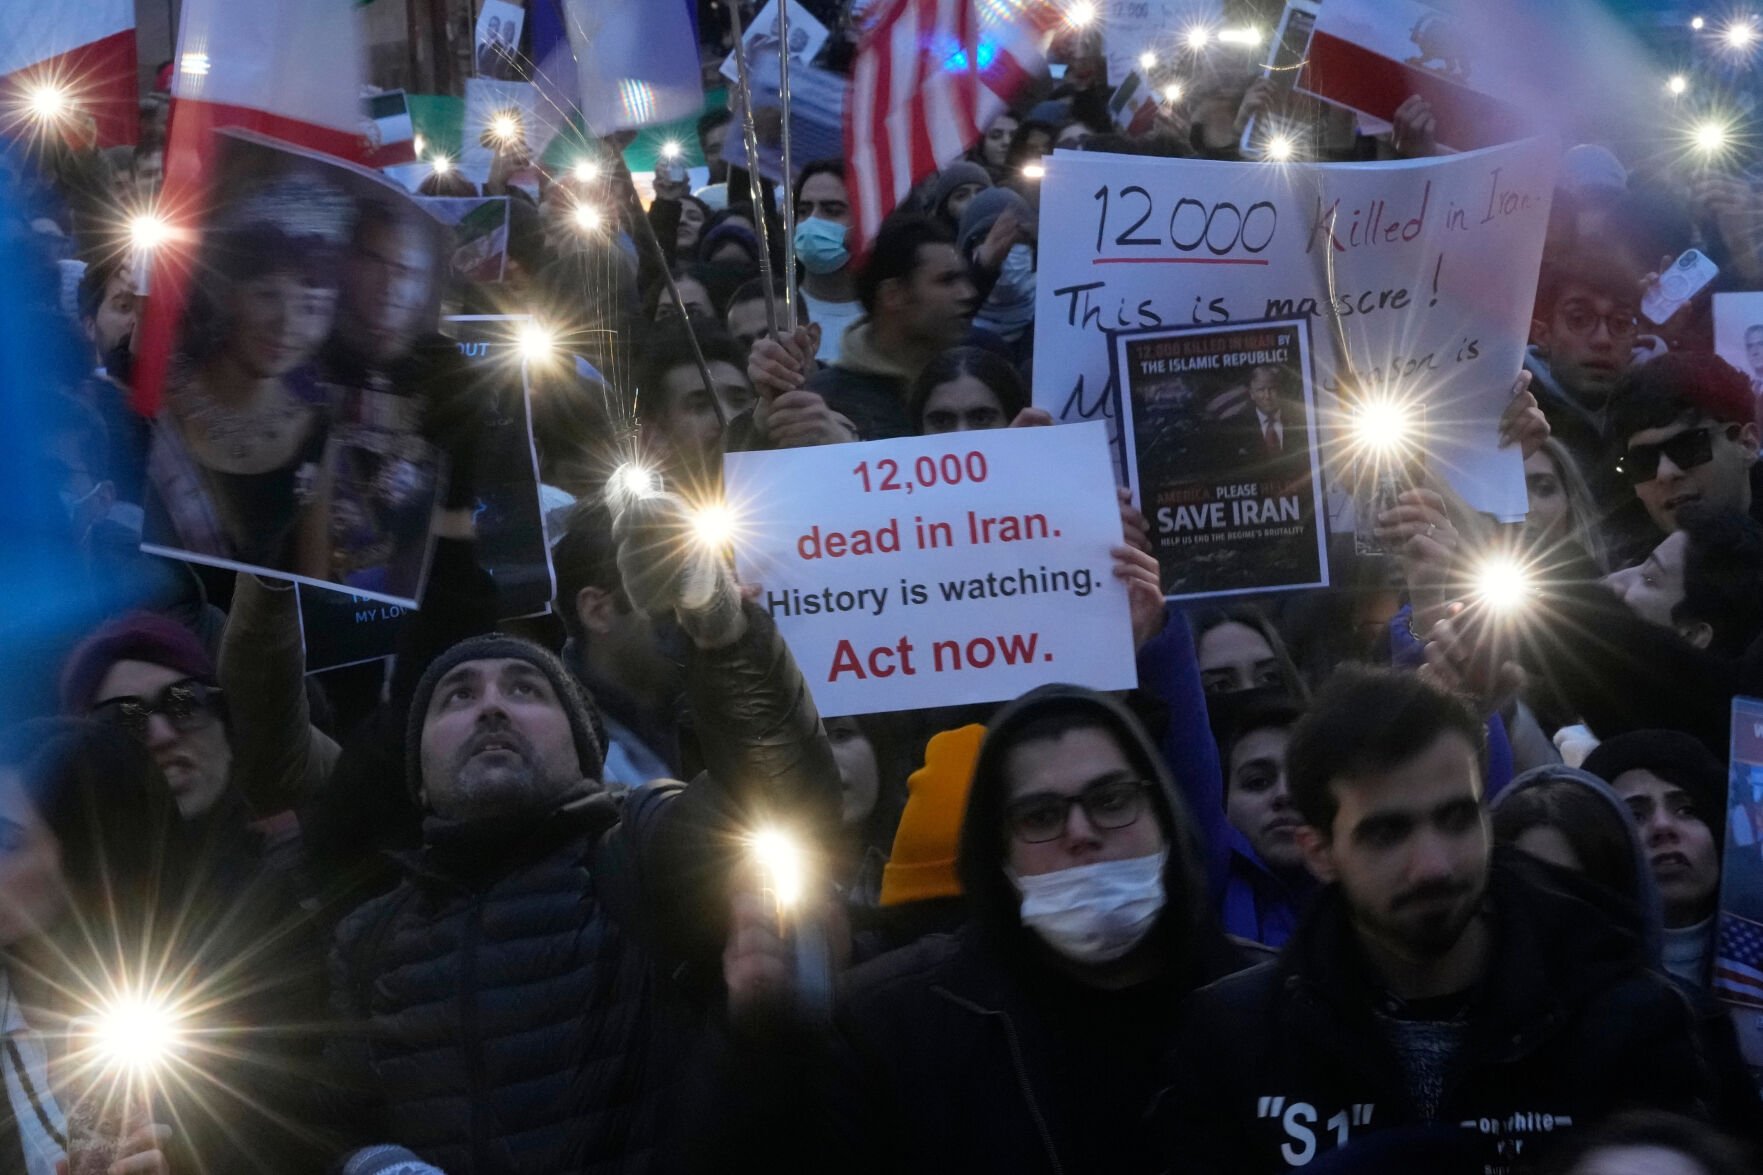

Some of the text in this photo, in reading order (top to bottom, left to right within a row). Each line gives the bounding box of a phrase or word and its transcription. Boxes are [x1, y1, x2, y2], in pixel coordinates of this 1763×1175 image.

[1306, 180, 1431, 253] Killed
[1446, 201, 1469, 231] in
[1053, 281, 1162, 332] This
[1192, 295, 1230, 325] is
[1277, 334, 1291, 346] BY
[1140, 348, 1289, 375] THE ISLAMIC REPUBLIC!
[853, 450, 988, 495] 12,000
[1216, 483, 1258, 500] PLEASE
[797, 510, 1062, 560] dead in Iran.
[1157, 501, 1227, 534] SAVE
[1232, 495, 1301, 527] IRAN
[1160, 535, 1181, 547] HELP
[1182, 535, 1193, 545] US
[1194, 534, 1210, 544] END
[1211, 532, 1226, 543] THE
[1264, 525, 1305, 538] BRUTALITY
[767, 565, 1102, 619] History is watching.
[355, 609, 377, 624] MY
[827, 632, 1053, 683] Act now.
